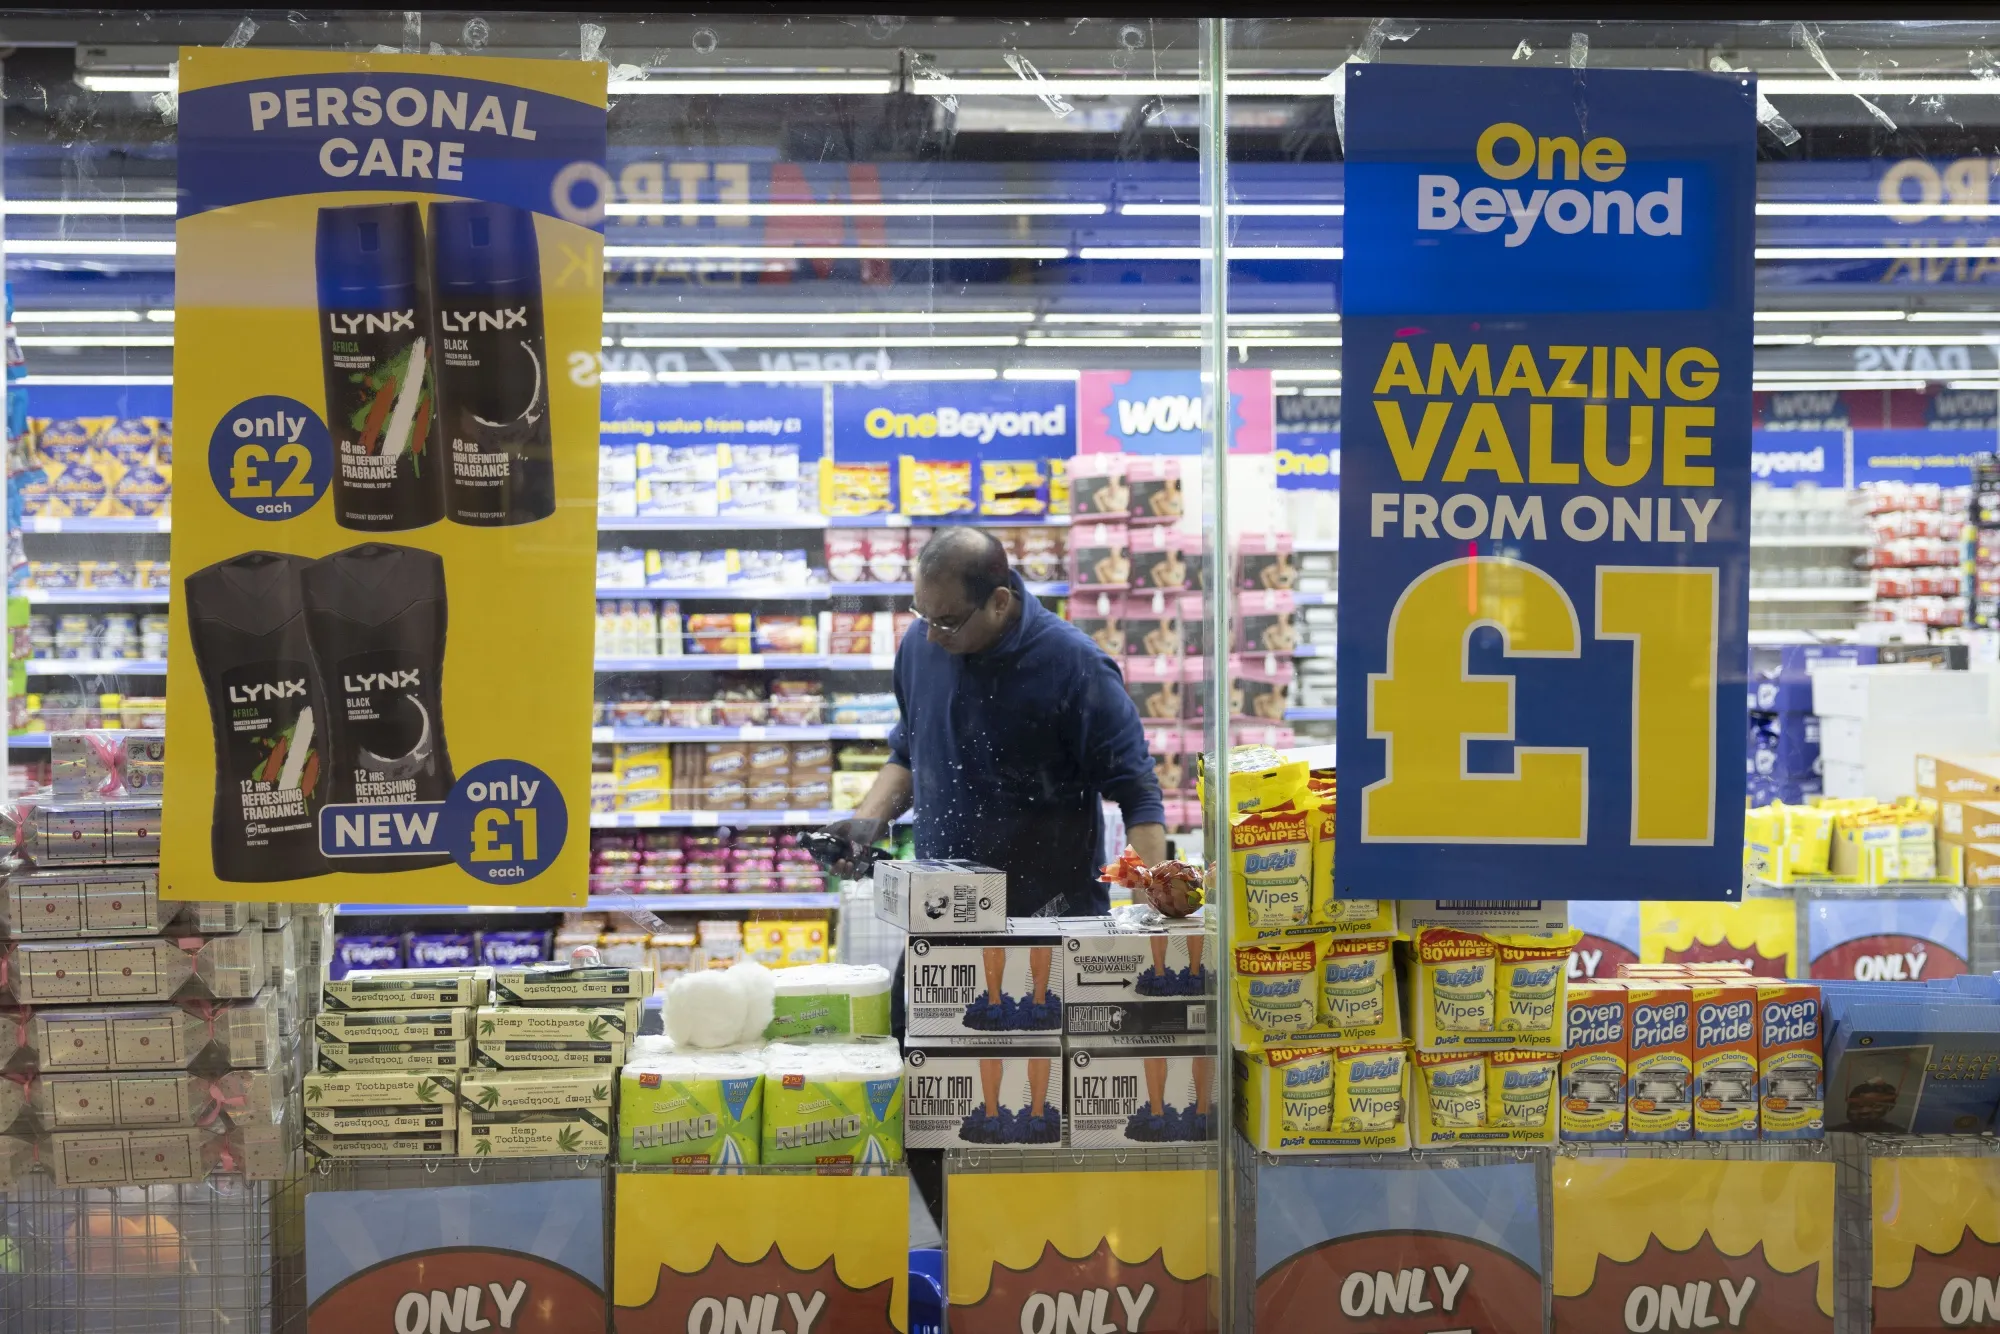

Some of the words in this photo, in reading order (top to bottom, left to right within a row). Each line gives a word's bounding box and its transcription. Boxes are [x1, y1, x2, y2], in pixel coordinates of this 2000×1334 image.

[249, 87, 537, 141] PERSONAL
[319, 138, 465, 181] CARE
[1476, 122, 1627, 183] One
[1417, 174, 1684, 248] Beyond
[330, 309, 414, 334] LYNX
[442, 306, 527, 332] LYNX
[333, 341, 359, 353] AFRICA
[444, 339, 468, 351] BLACK
[1373, 342, 1720, 401] AMAZING
[232, 410, 307, 440] only
[746, 417, 783, 436] only
[340, 440, 350, 454] 48
[352, 445, 366, 455] HRS
[452, 438, 463, 452] 48
[464, 443, 478, 453] HRS
[1373, 400, 1716, 487] VALUE
[341, 455, 355, 465] HIGH
[356, 455, 397, 466] DEFINITION
[453, 452, 468, 463] HIGH
[468, 452, 509, 464] DEFINITION
[229, 444, 315, 499] £2
[342, 465, 398, 480] FRAGRANCE
[454, 463, 511, 477] FRAGRANCE
[256, 501, 292, 516] each
[367, 513, 394, 521] BODYSPRAY
[480, 511, 506, 519] BODYSPRAY
[1371, 493, 1547, 541] FROM
[1561, 495, 1723, 544] ONLY
[343, 668, 421, 693] LYNX
[229, 678, 307, 704] LYNX
[346, 697, 370, 708] BLACK
[1361, 555, 1720, 846] £1
[233, 707, 259, 719] AFRICA
[354, 769, 367, 783] 12
[369, 771, 385, 781] HRS
[240, 780, 253, 793] 12
[255, 782, 271, 791] HRS
[355, 779, 416, 796] REFRESHING
[466, 774, 540, 807] only
[241, 788, 303, 807] REFRESHING
[243, 802, 304, 820] FRAGRANCE
[335, 812, 439, 847] NEW
[470, 807, 538, 862] £1
[1234, 833, 1255, 845] 80
[1256, 829, 1307, 841] WIPES
[1245, 849, 1297, 875] Duzzit
[488, 865, 525, 878] each
[1247, 889, 1299, 909] Wipes
[1339, 921, 1372, 933] Wipes
[1336, 941, 1386, 953] WIPES
[1423, 948, 1443, 961] 80
[1445, 947, 1495, 957] WIPES
[1073, 955, 1104, 963] CLEAN
[1106, 955, 1143, 963] WHILST
[1239, 952, 1272, 961] MEGA
[1275, 951, 1311, 960] VALUE
[1082, 964, 1102, 972] YOU
[1104, 963, 1135, 972] WALK!
[1239, 962, 1259, 973] 80
[1261, 960, 1312, 972] WIPES
[1326, 960, 1375, 984] Duzzit
[1854, 951, 1928, 982] ONLY
[913, 964, 947, 987] LAZY
[951, 964, 976, 987] MAN
[524, 985, 578, 994] Toothpaste
[913, 987, 959, 1004] CLEANING
[962, 987, 976, 1004] KIT
[1250, 978, 1301, 997] Duzzit
[352, 994, 406, 1003] Toothpaste
[1327, 996, 1378, 1018] Wipes
[1250, 1006, 1302, 1027] Wipes
[1435, 1000, 1485, 1022] Wipes
[1569, 1004, 1621, 1025] Oven
[1635, 1004, 1686, 1025] Oven
[1700, 1002, 1750, 1024] Oven
[1765, 1002, 1815, 1023] Oven
[497, 1018, 523, 1026] Hemp
[528, 1018, 586, 1028] Toothpaste
[345, 1028, 399, 1036] Toothpaste
[1344, 1028, 1376, 1039] Wipes
[1518, 1035, 1551, 1045] Wipes
[1568, 1021, 1622, 1047] Pride
[1634, 1021, 1687, 1047] Pride
[1700, 1019, 1751, 1045] Pride
[1765, 1019, 1816, 1045] Pride
[348, 1057, 403, 1065] Toothpaste
[505, 1054, 560, 1063] Toothpaste
[1272, 1049, 1293, 1062] 80
[1570, 1057, 1588, 1069] Deep
[1590, 1053, 1617, 1063] Cleaner
[1637, 1057, 1654, 1069] Deep
[1656, 1053, 1683, 1063] Cleaner
[1702, 1056, 1719, 1068] Deep
[1722, 1053, 1749, 1061] Cleaner
[1787, 1052, 1814, 1061] Cleaner
[1942, 1055, 1998, 1063] HEAD
[641, 1073, 648, 1083] 2
[1285, 1061, 1330, 1087] Duzzit
[1349, 1057, 1399, 1082] Duzzit
[1935, 1072, 1989, 1080] GAME
[323, 1083, 351, 1092] Hemp
[355, 1082, 415, 1091] Toothpaste
[728, 1082, 749, 1090] TWIN
[783, 1075, 790, 1084] 2
[909, 1076, 943, 1098] LAZY
[947, 1076, 973, 1098] MAN
[1074, 1076, 1108, 1099] LAZY
[1112, 1076, 1138, 1098] MAN
[502, 1097, 561, 1106] Toothpaste
[565, 1095, 592, 1103] Hemp
[653, 1096, 690, 1113] Freedom
[796, 1099, 832, 1114] Freedom
[909, 1100, 954, 1116] CLEANING
[958, 1099, 972, 1116] KIT
[1074, 1099, 1119, 1116] CLEANING
[1123, 1098, 1138, 1115] KIT
[1349, 1097, 1399, 1118] Wipes
[1285, 1101, 1332, 1121] Wipes
[1431, 1098, 1481, 1119] Wipes
[334, 1119, 390, 1128] Toothpaste
[511, 1126, 537, 1136] Hemp
[633, 1113, 717, 1150] RHINO
[775, 1113, 861, 1150] RHINO
[495, 1135, 553, 1145] Toothpaste
[1364, 1136, 1396, 1147] Wipes
[1512, 1131, 1544, 1141] Wipes
[333, 1142, 389, 1151] Toothpaste
[1340, 1264, 1470, 1317] ONLY
[395, 1279, 527, 1334] ONLY
[1020, 1283, 1154, 1334] ONLY
[1624, 1276, 1756, 1333] ONLY
[1939, 1276, 2000, 1326] ON
[687, 1290, 826, 1334] ONLY
